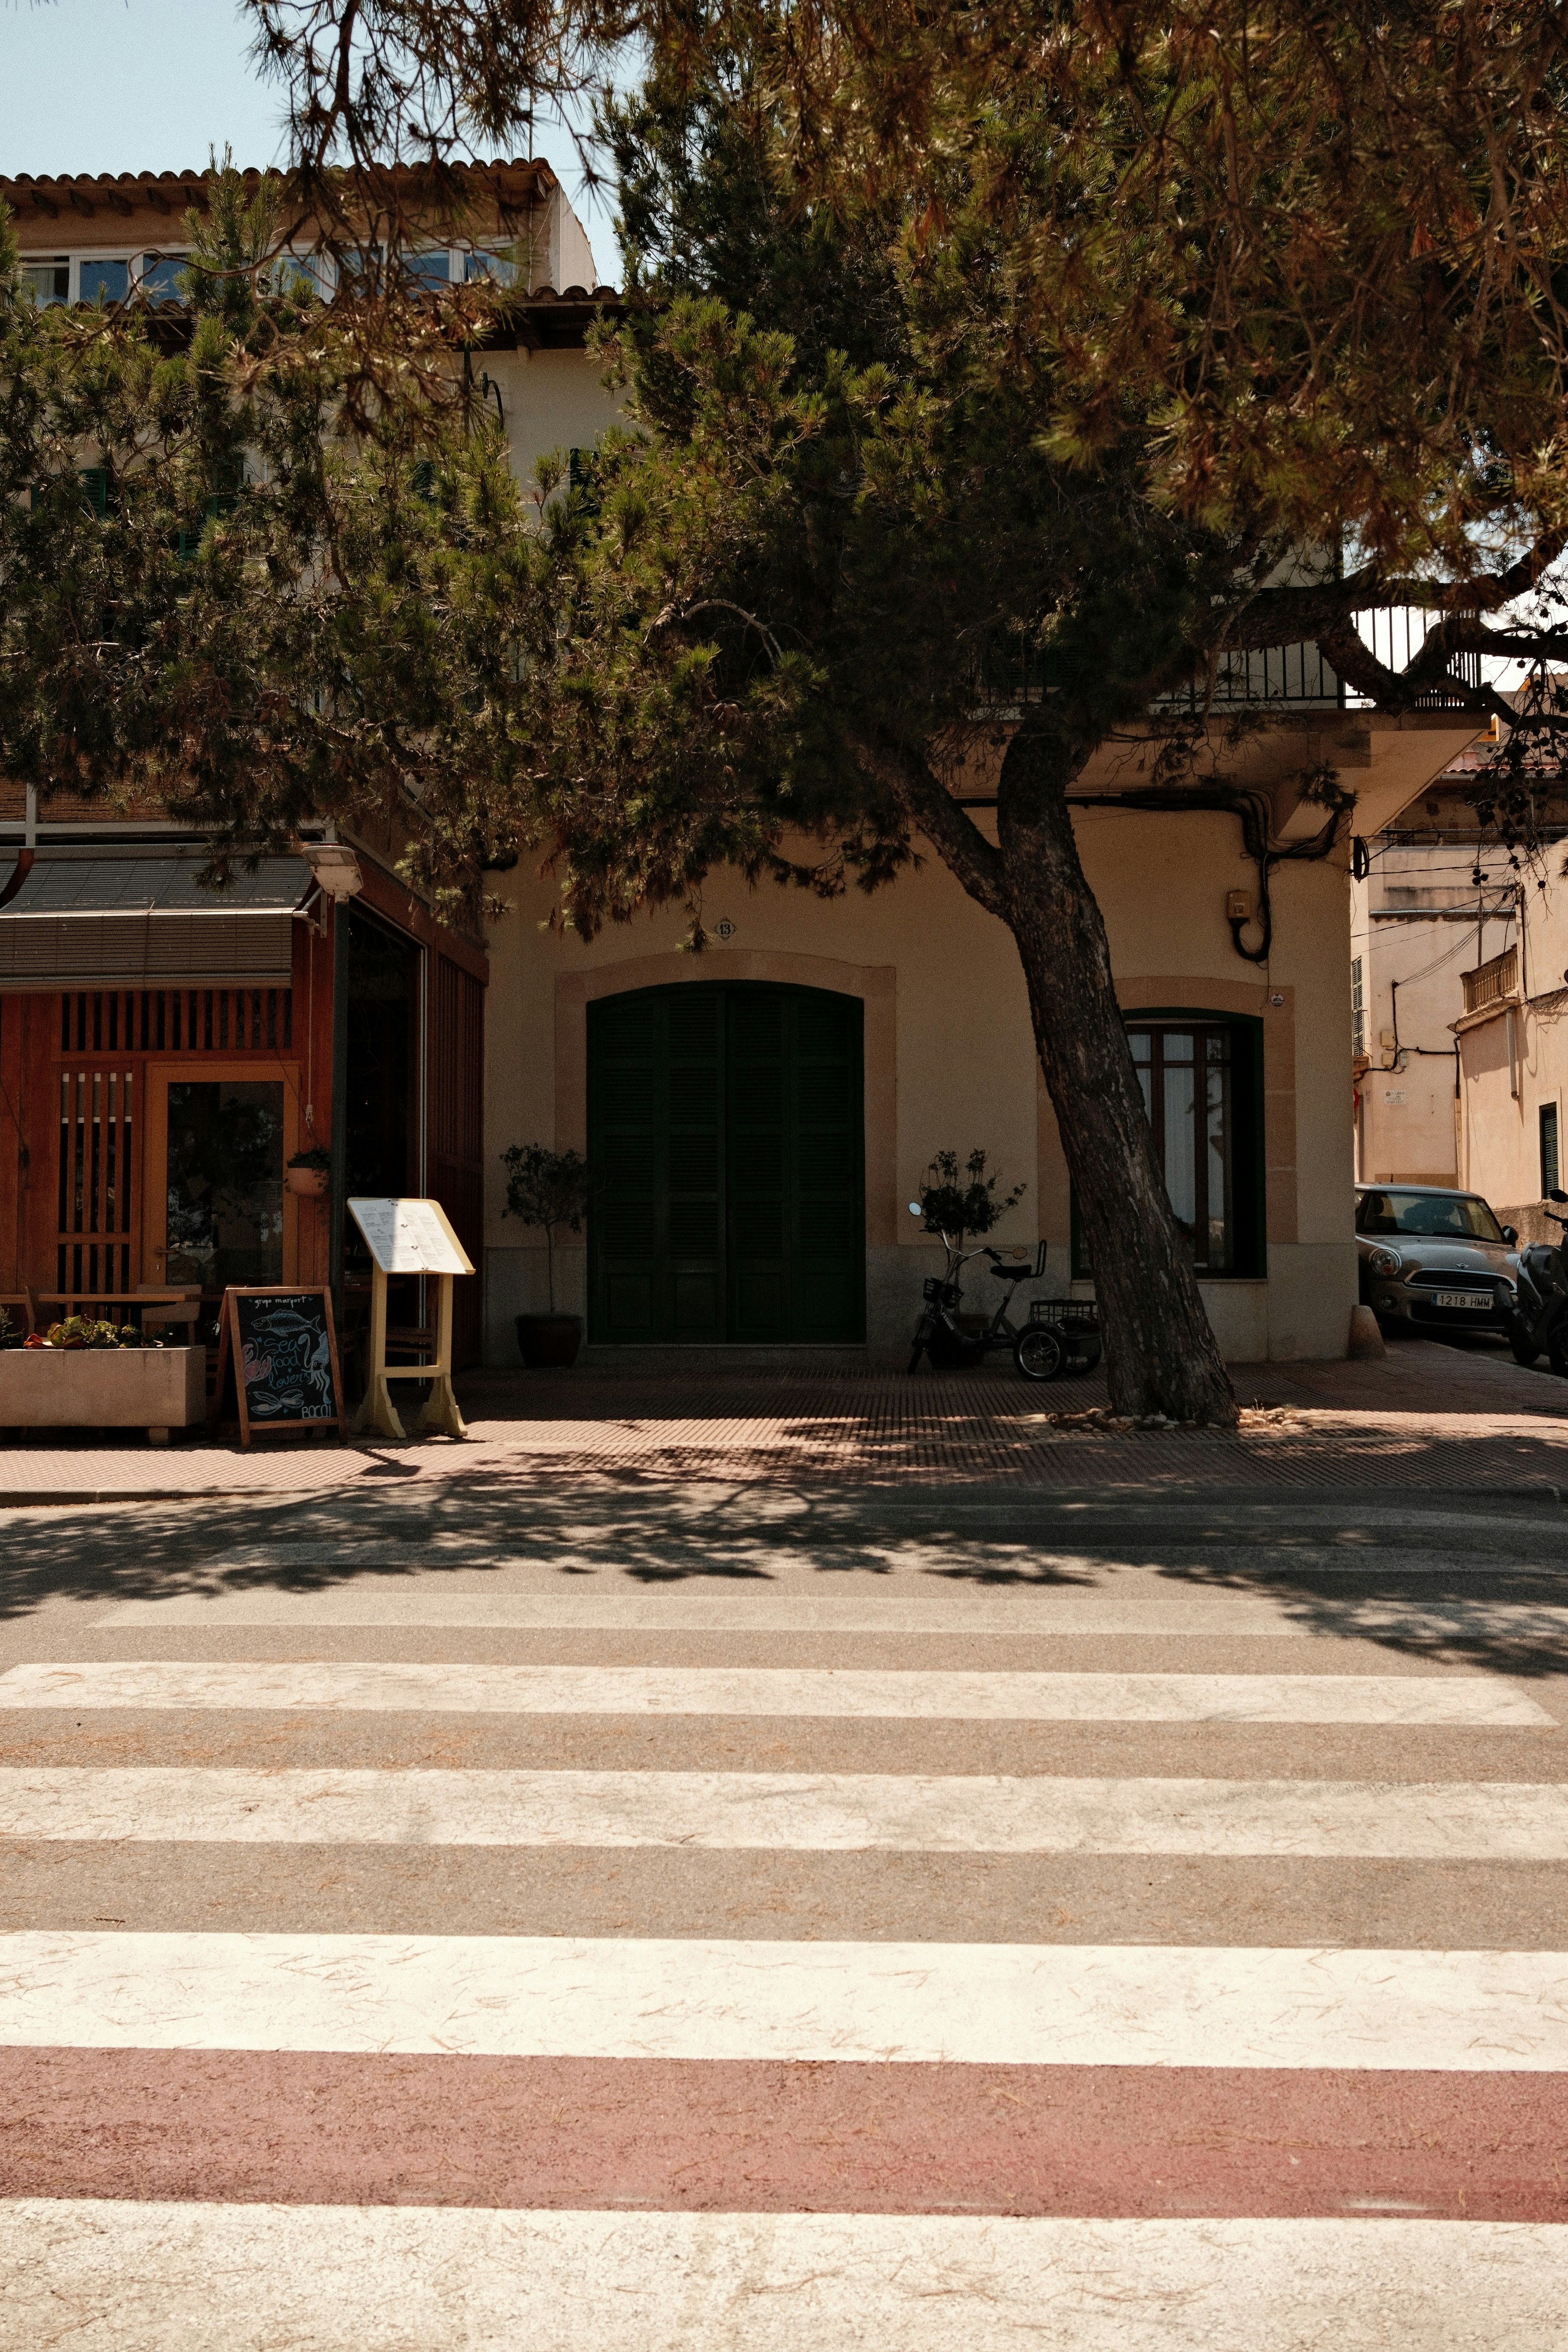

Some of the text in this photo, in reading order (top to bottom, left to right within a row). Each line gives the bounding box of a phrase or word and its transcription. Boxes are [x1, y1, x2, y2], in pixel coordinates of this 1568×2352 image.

[720, 924, 731, 934] 13
[254, 1295, 307, 1308] grupo marport
[1440, 1295, 1490, 1308] 1218 HMM
[271, 1351, 300, 1374] food
[269, 1372, 311, 1390] lovers
